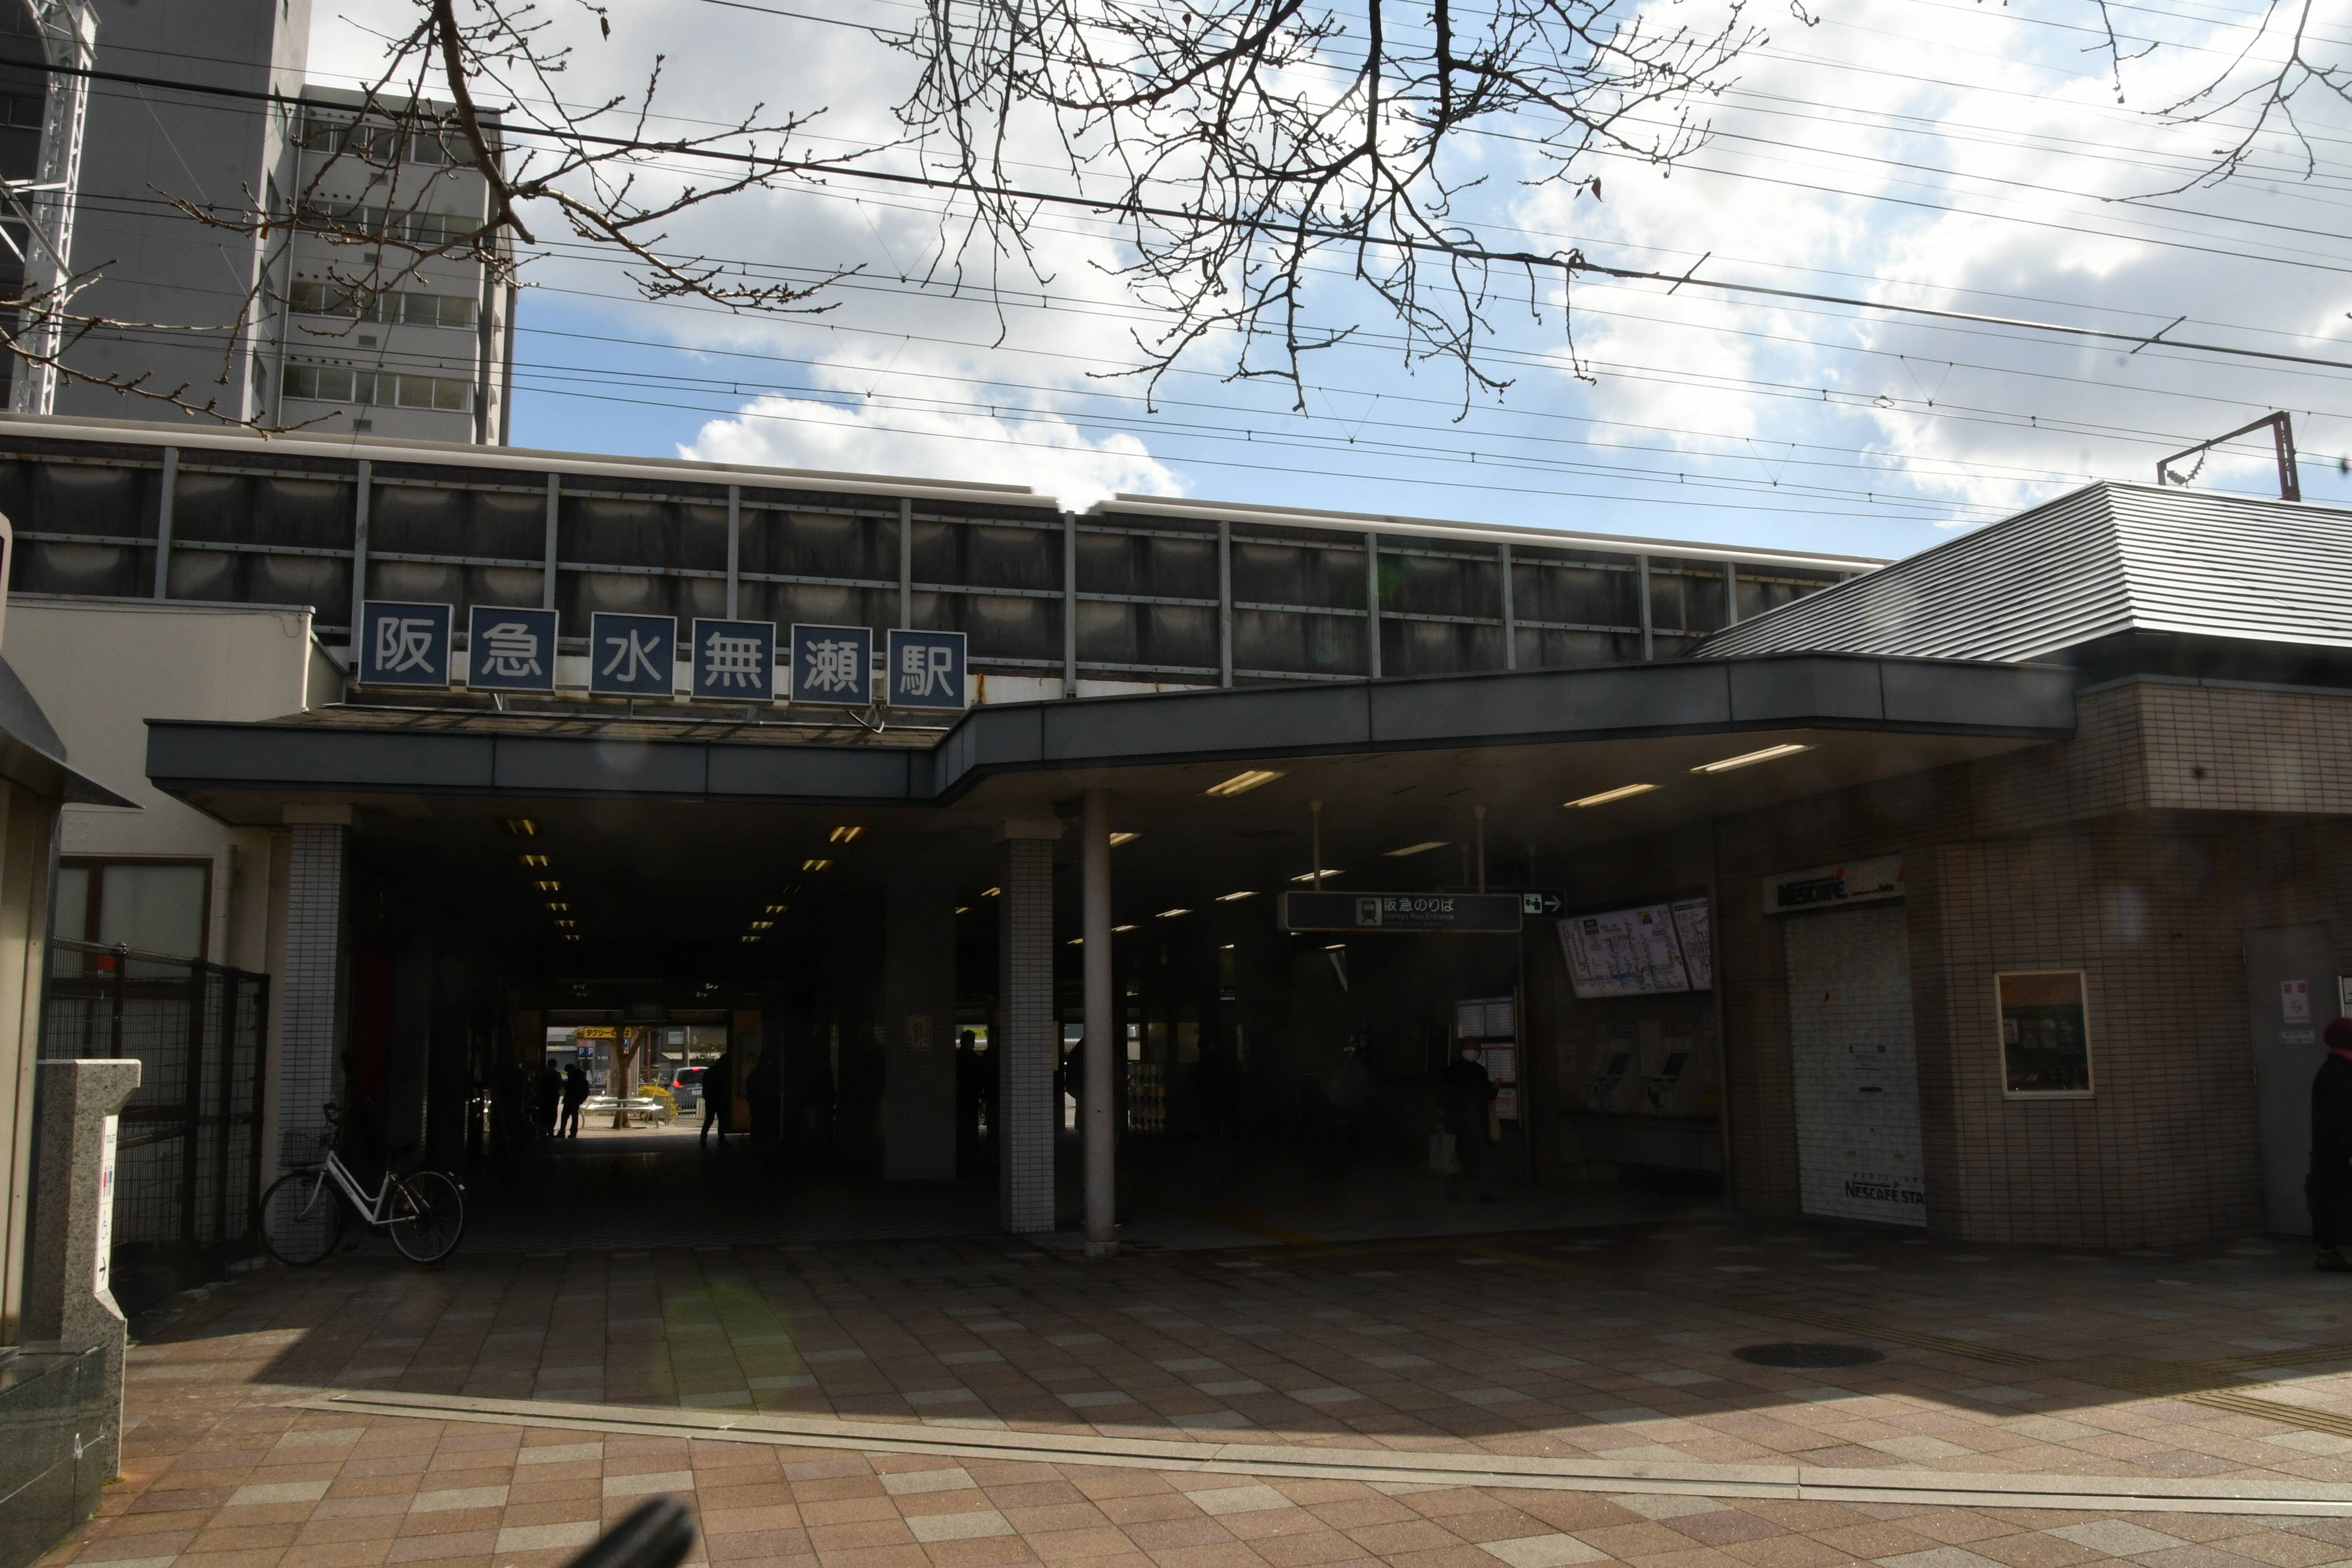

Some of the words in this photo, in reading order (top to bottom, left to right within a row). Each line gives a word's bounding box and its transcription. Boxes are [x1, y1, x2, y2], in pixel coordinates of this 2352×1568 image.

[1384, 898, 1454, 912] 阪急のりば
